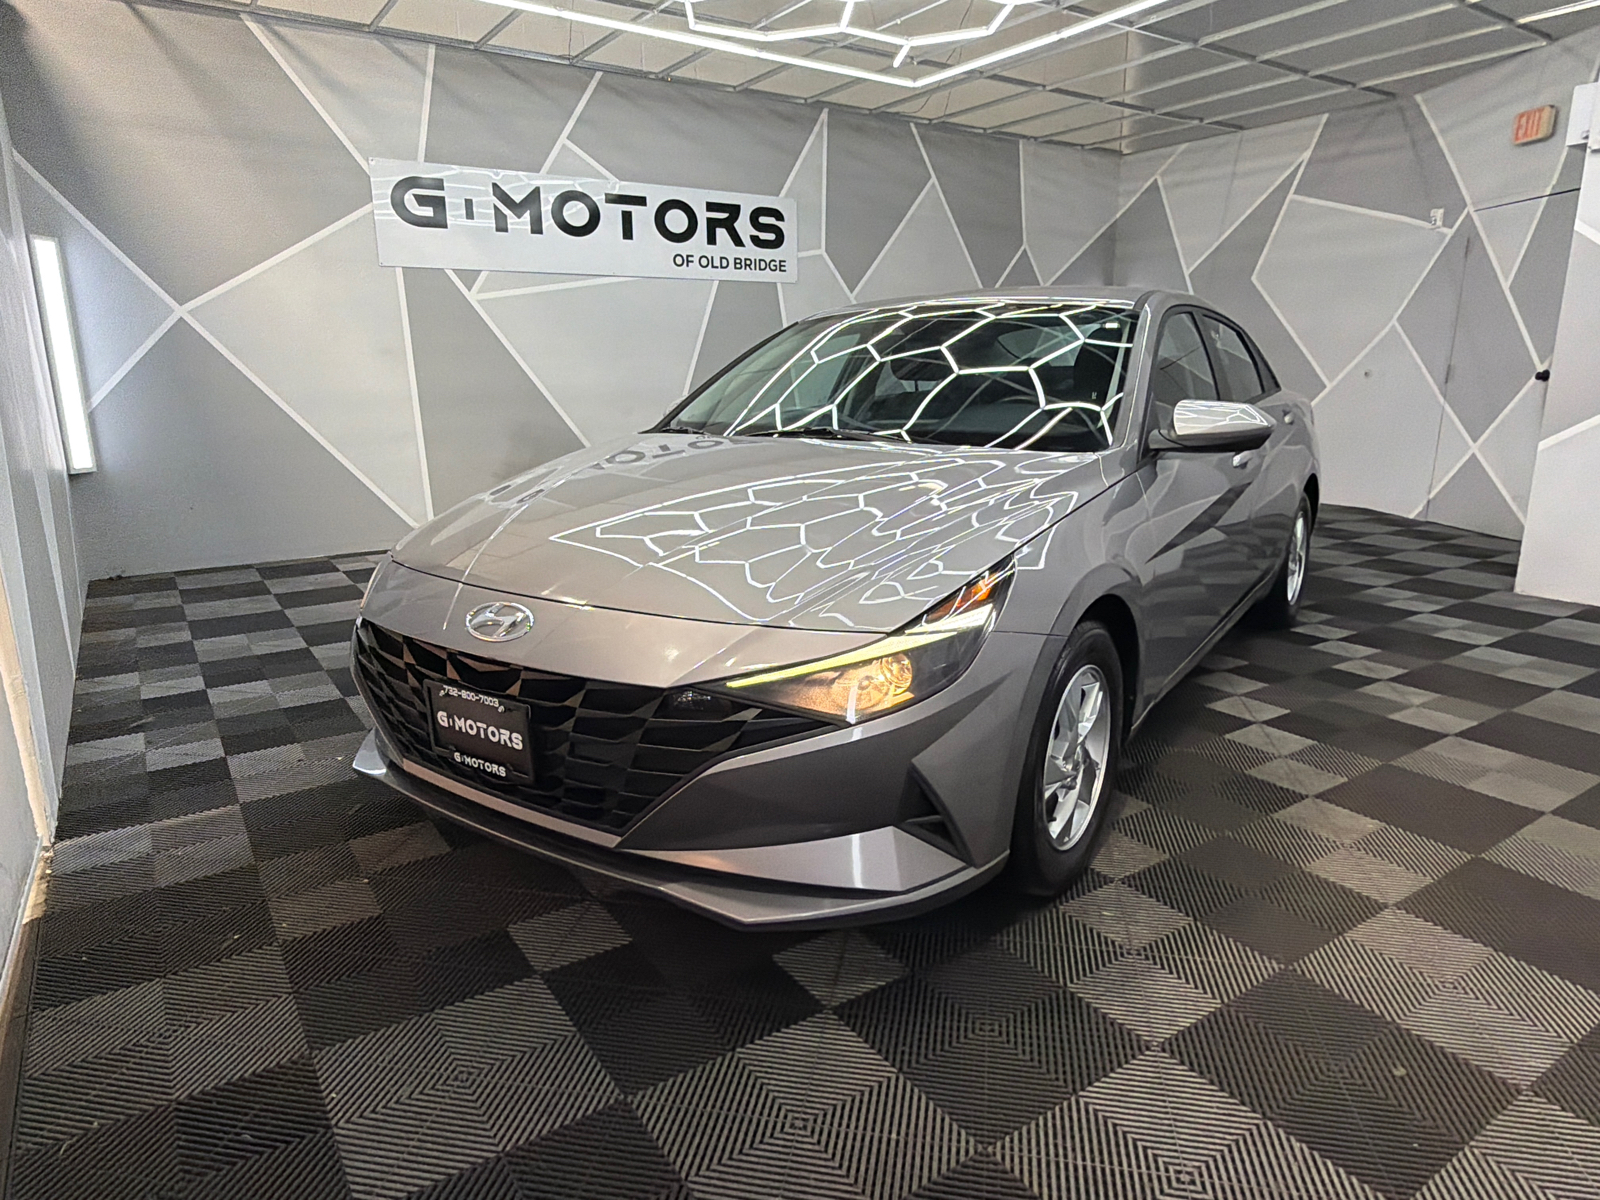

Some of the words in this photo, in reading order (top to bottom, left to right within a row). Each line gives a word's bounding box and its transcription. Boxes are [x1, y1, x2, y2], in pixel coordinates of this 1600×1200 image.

[673, 253, 695, 268] OF
[698, 255, 730, 270] OLD
[733, 257, 787, 273] BRIDGE
